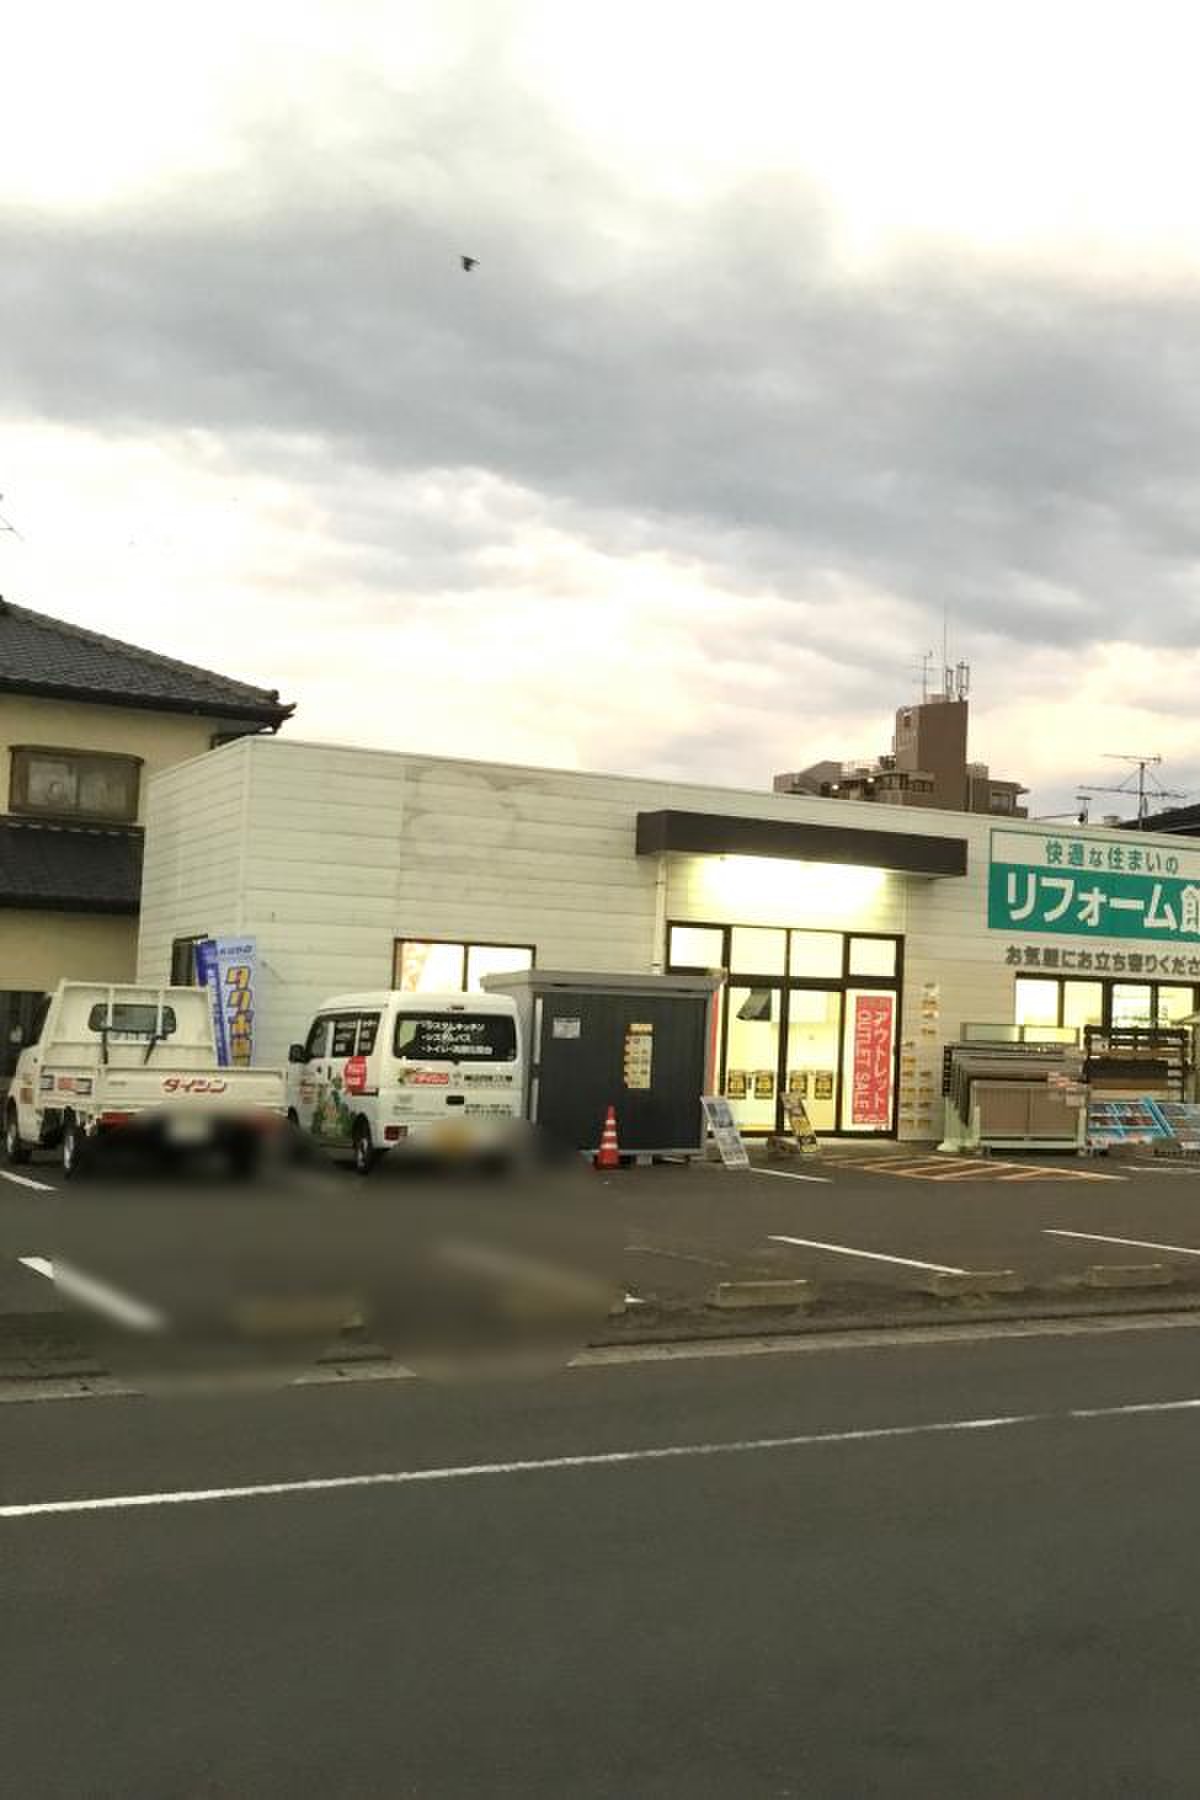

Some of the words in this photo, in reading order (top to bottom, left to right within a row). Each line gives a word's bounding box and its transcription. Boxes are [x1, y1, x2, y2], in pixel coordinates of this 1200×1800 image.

[1046, 839, 1179, 875] 快適な住まいの
[856, 1010, 873, 1066] OUTLET
[163, 1078, 227, 1094] ダイシン
